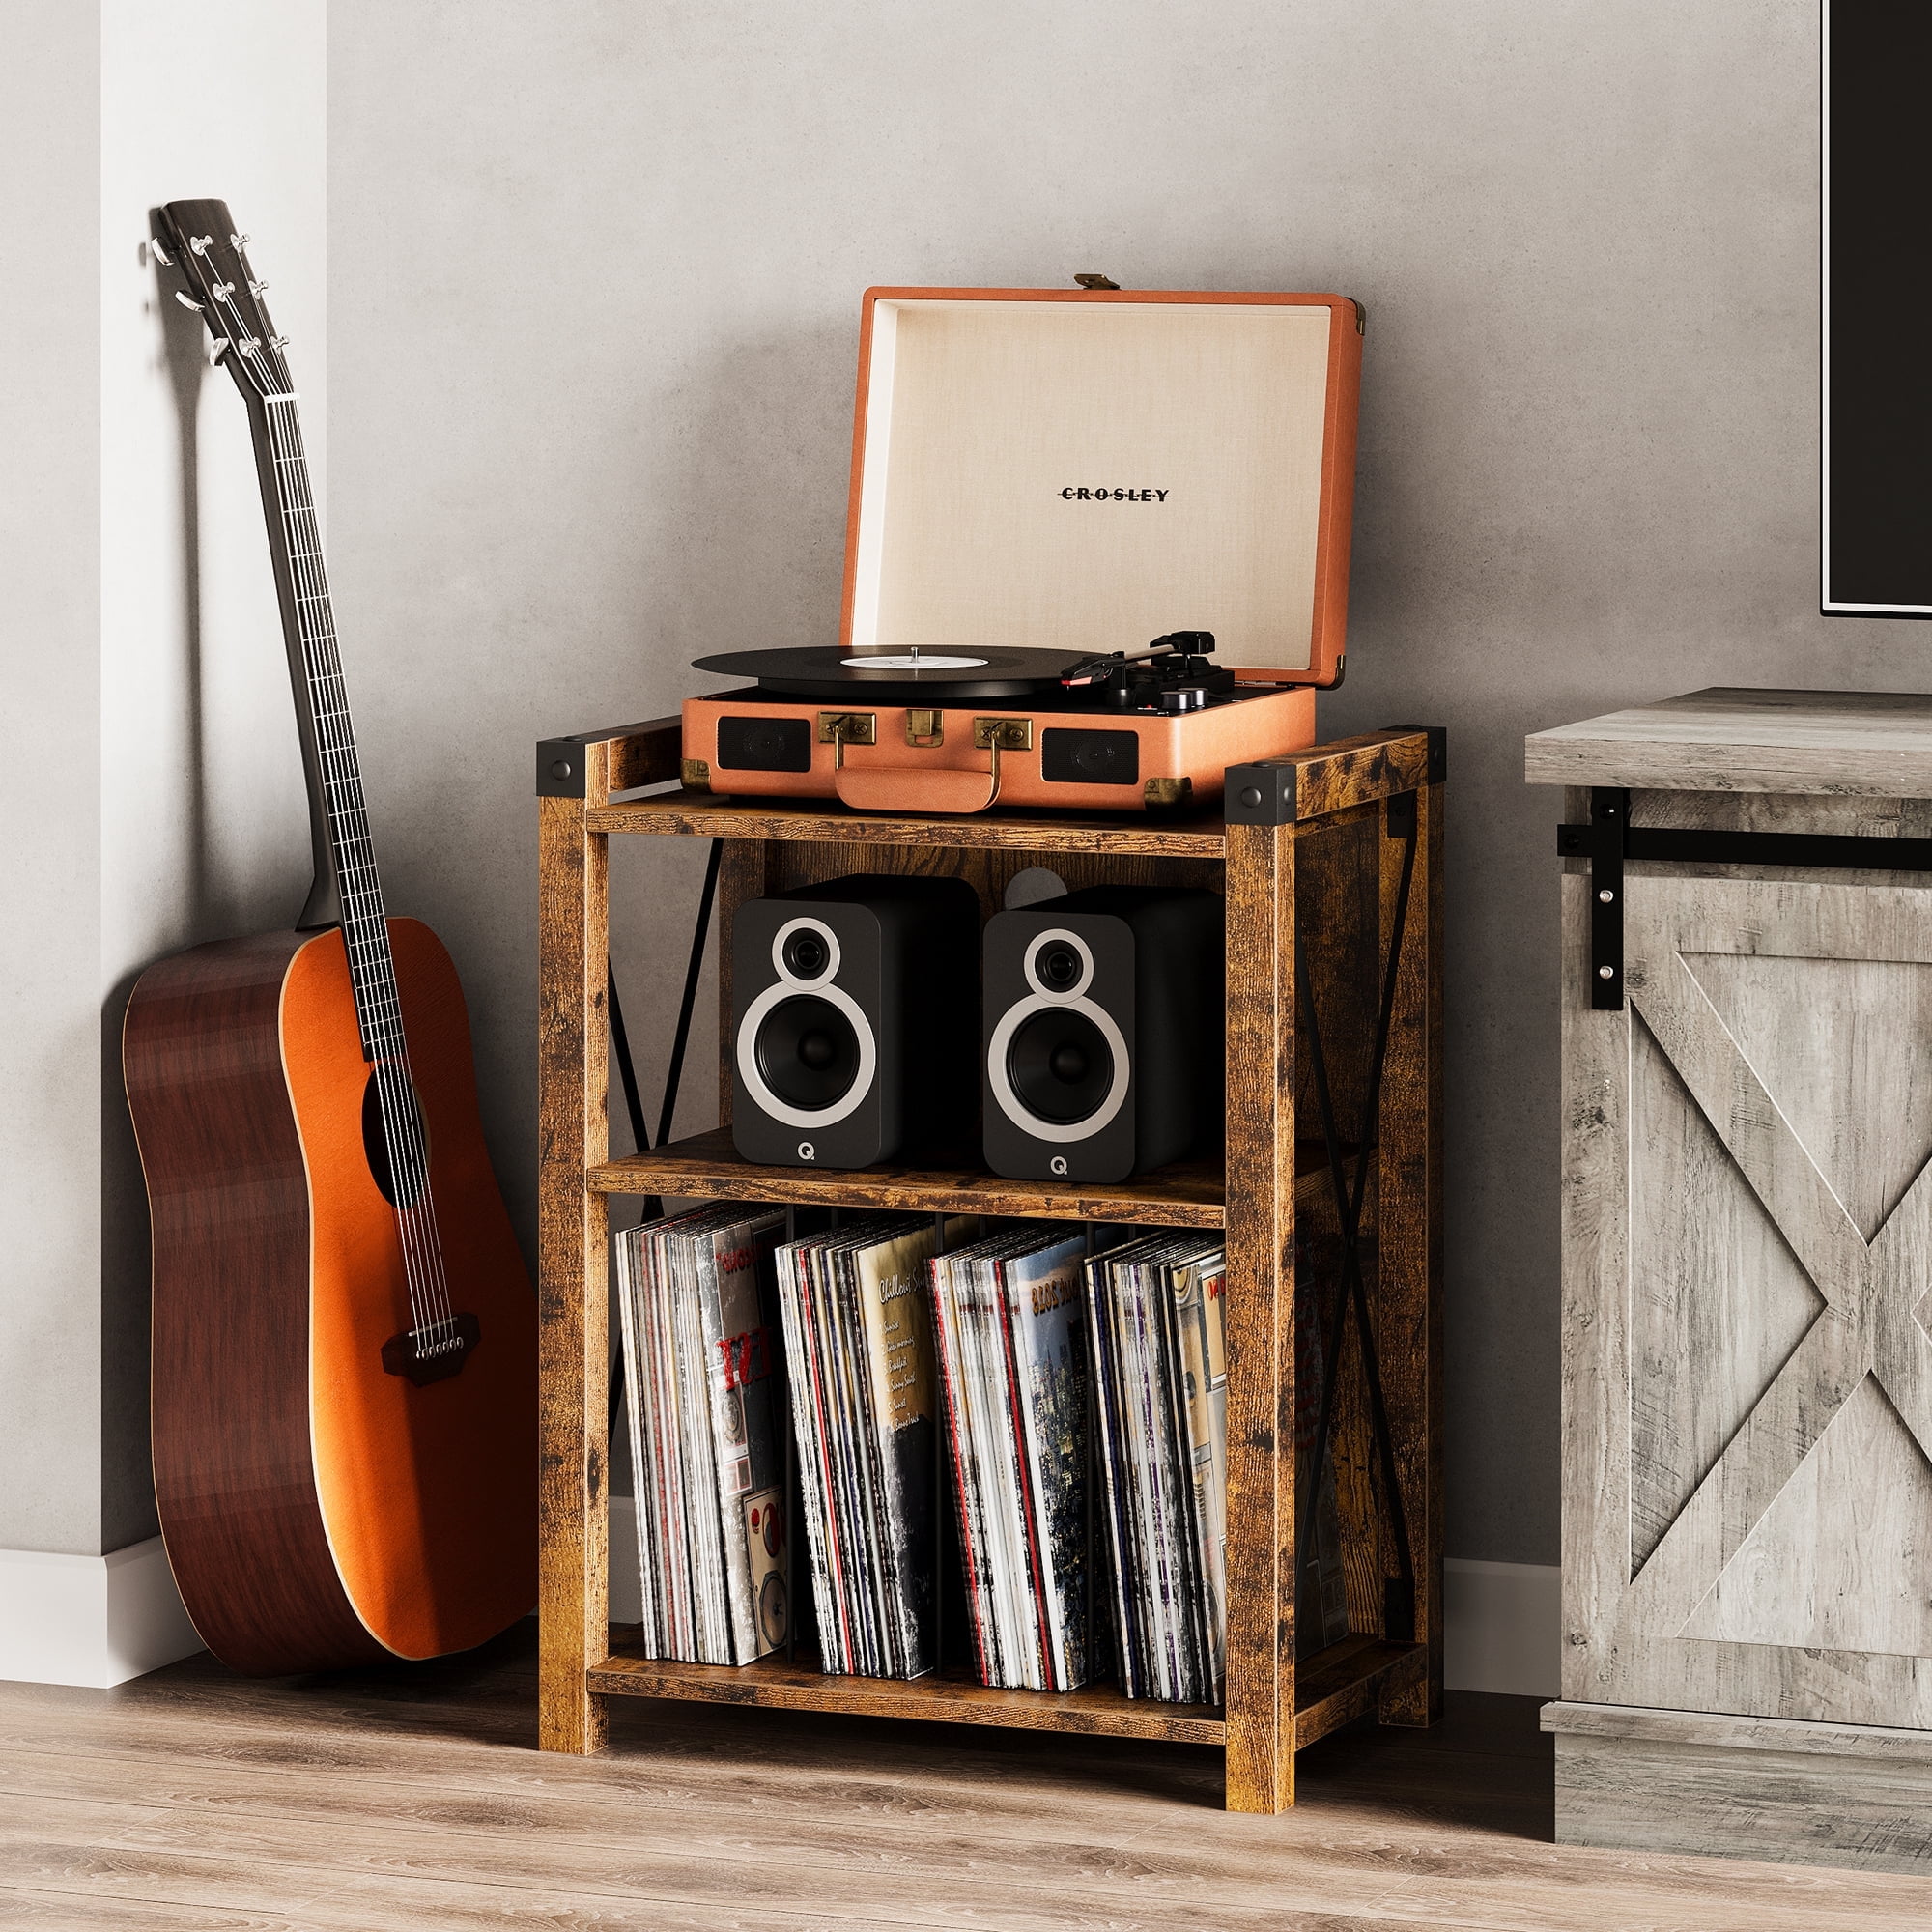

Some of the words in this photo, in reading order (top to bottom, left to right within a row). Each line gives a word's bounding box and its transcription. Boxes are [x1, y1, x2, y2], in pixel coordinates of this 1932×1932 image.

[1059, 487, 1170, 502] CROSLEY
[797, 1141, 815, 1160] Q
[1050, 1155, 1068, 1175] Q
